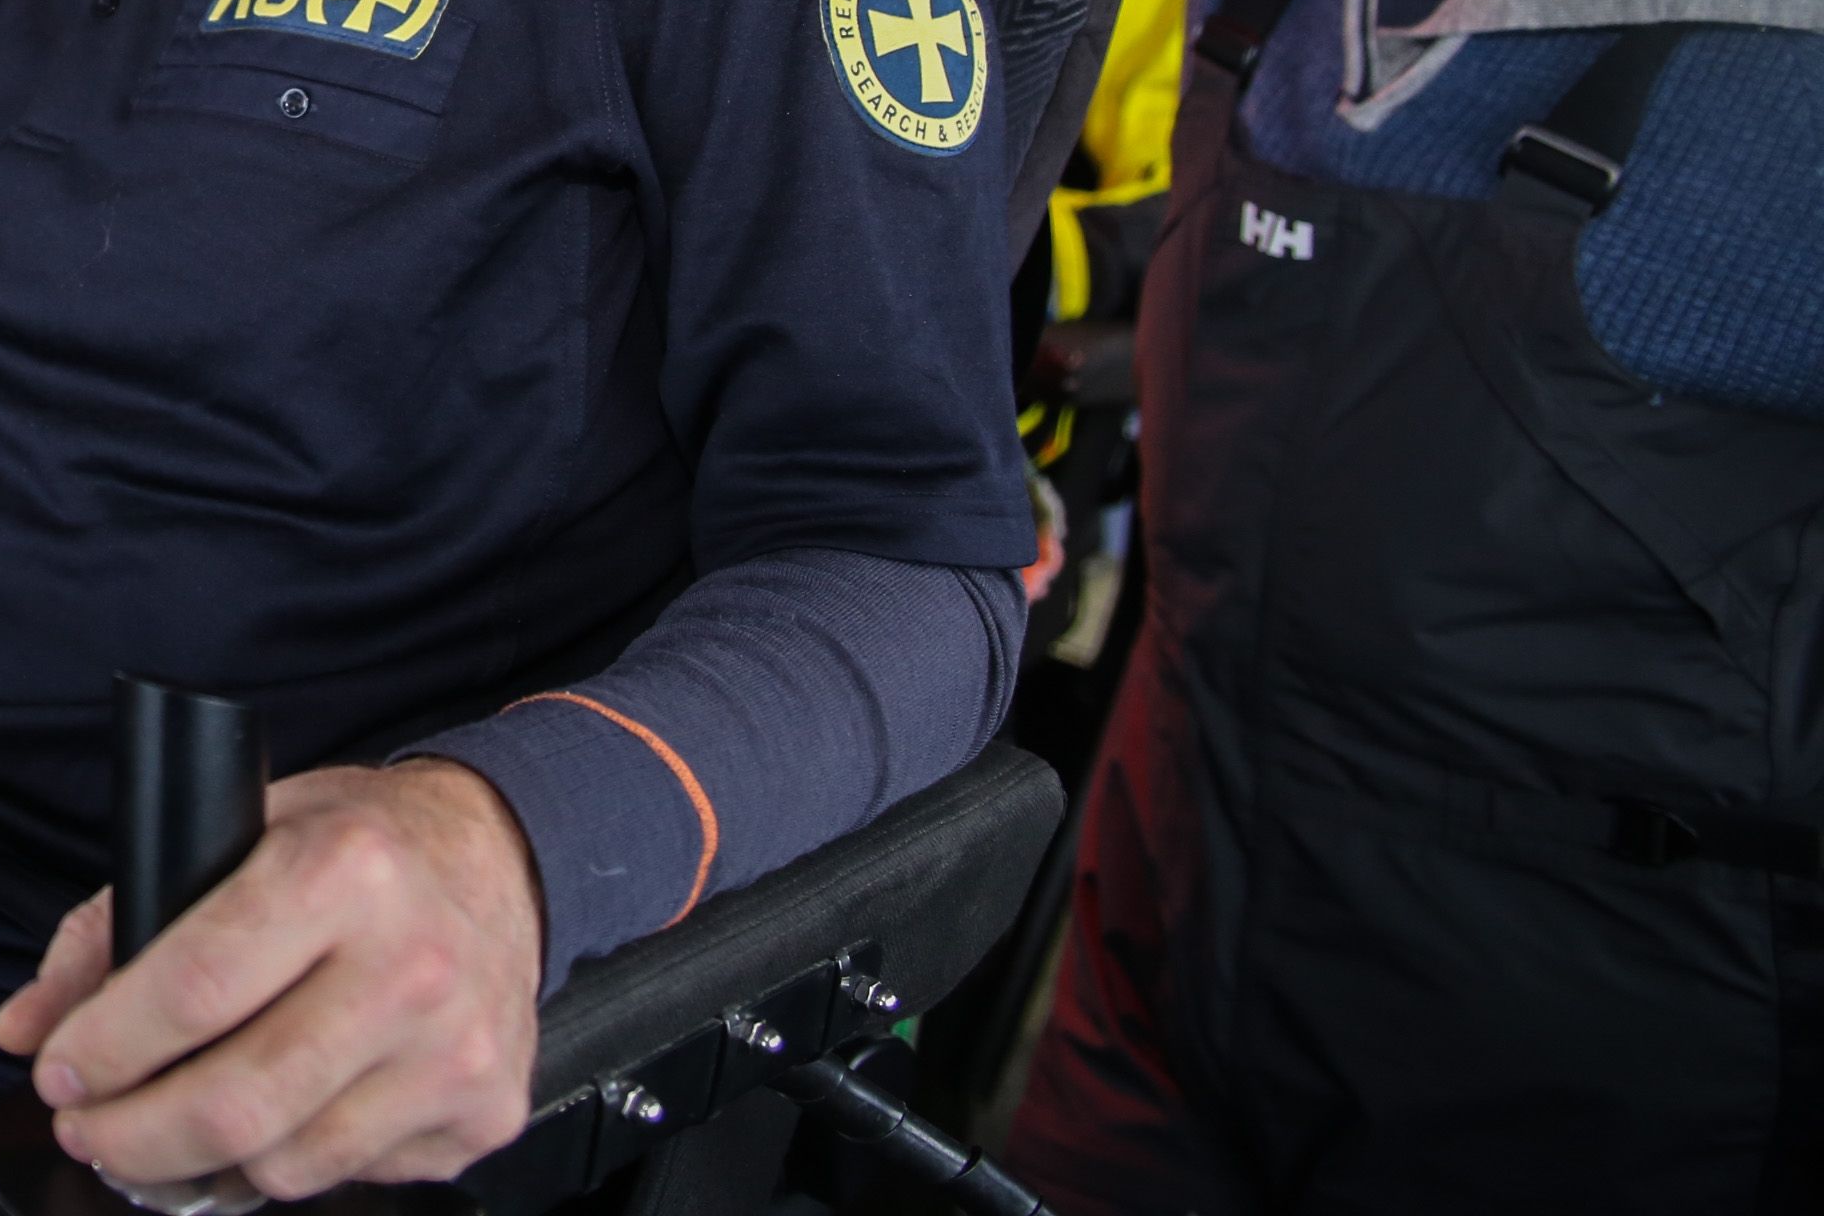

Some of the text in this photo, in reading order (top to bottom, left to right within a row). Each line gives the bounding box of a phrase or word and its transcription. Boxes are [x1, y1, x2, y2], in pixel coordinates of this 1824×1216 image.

[850, 59, 927, 141] SEARCH
[938, 124, 949, 143] &
[1240, 200, 1314, 261] HH
